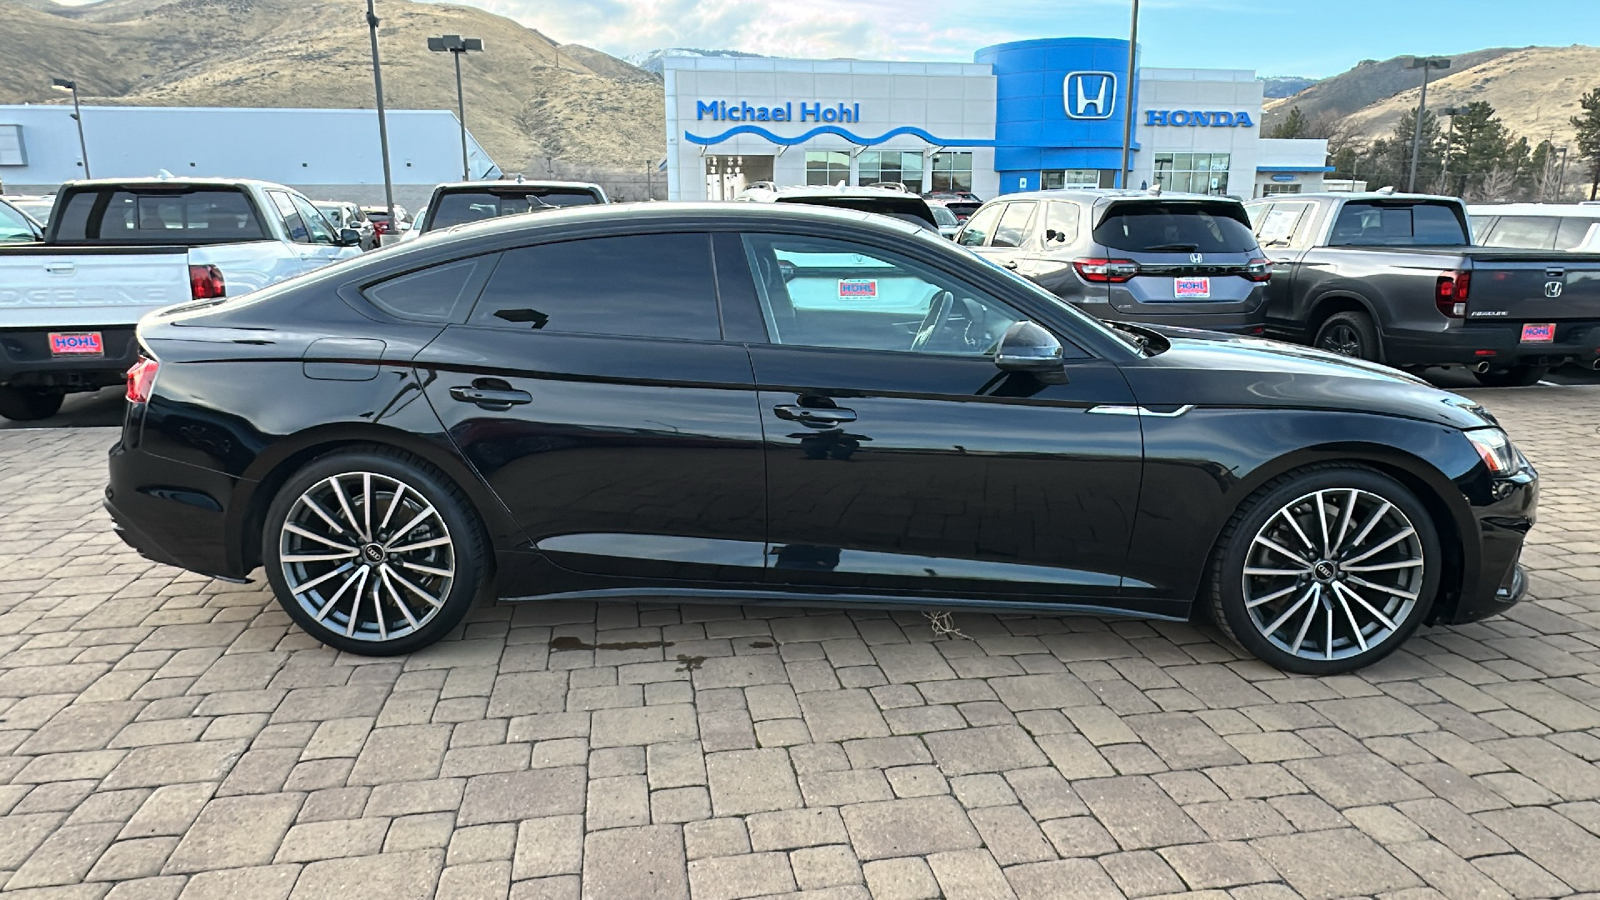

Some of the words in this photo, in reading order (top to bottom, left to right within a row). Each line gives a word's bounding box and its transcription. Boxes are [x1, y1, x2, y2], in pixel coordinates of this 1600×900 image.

[696, 100, 792, 122] Michael
[801, 102, 860, 123] Hohl
[1145, 110, 1254, 127] HONDA
[842, 284, 873, 292] HOHL
[1178, 282, 1204, 290] HOHL
[1524, 327, 1550, 336] HOHL
[55, 337, 98, 347] HOHL
